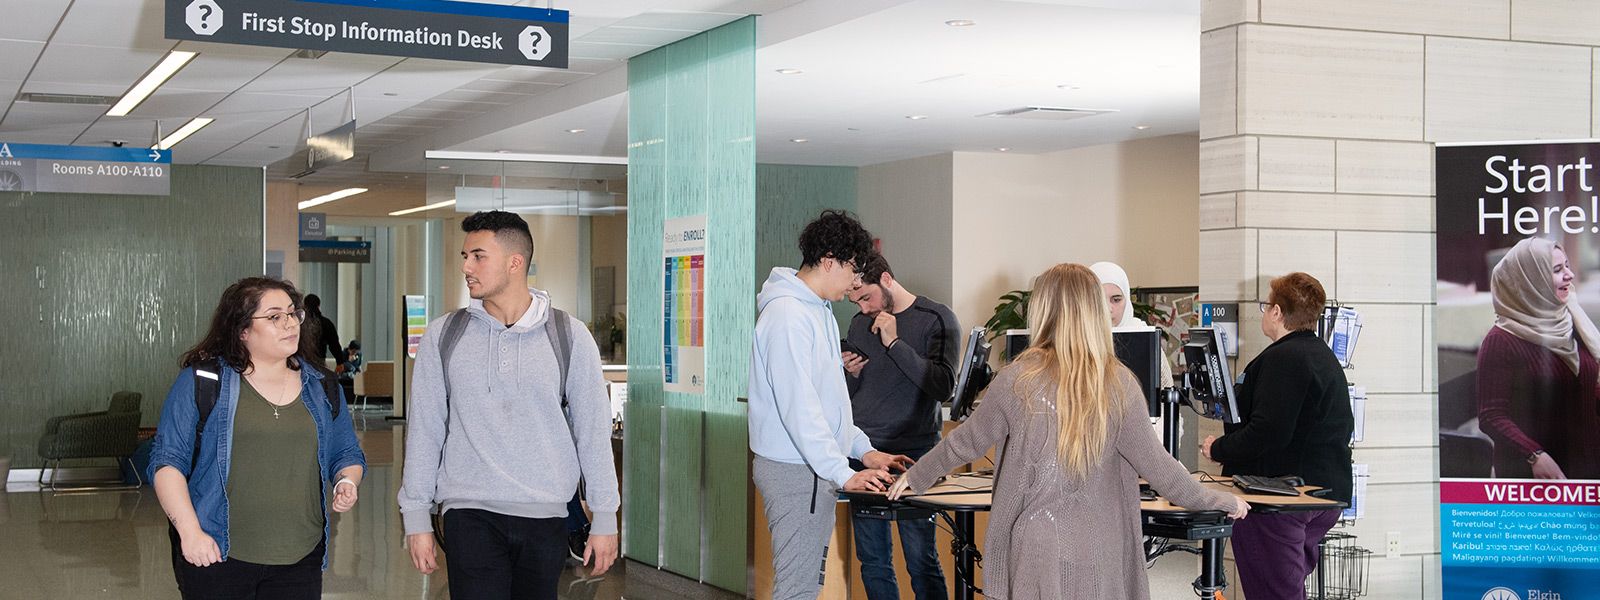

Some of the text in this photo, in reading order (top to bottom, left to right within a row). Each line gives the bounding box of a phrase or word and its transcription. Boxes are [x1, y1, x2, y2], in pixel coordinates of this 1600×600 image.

[242, 12, 503, 50] First Stop Information Desk
[0, 142, 13, 157] A
[52, 163, 163, 177] Rooms A100-A110
[1485, 155, 1593, 194] Start
[1478, 195, 1599, 235] Here!
[1204, 308, 1226, 316] A 100
[1451, 509, 1499, 517] Bienvenidos!
[1452, 520, 1496, 528] Tervetuloa!
[1505, 532, 1550, 540] Bienvenue!
[1452, 541, 1484, 550] Karibu!
[1452, 553, 1499, 563] Maligayang
